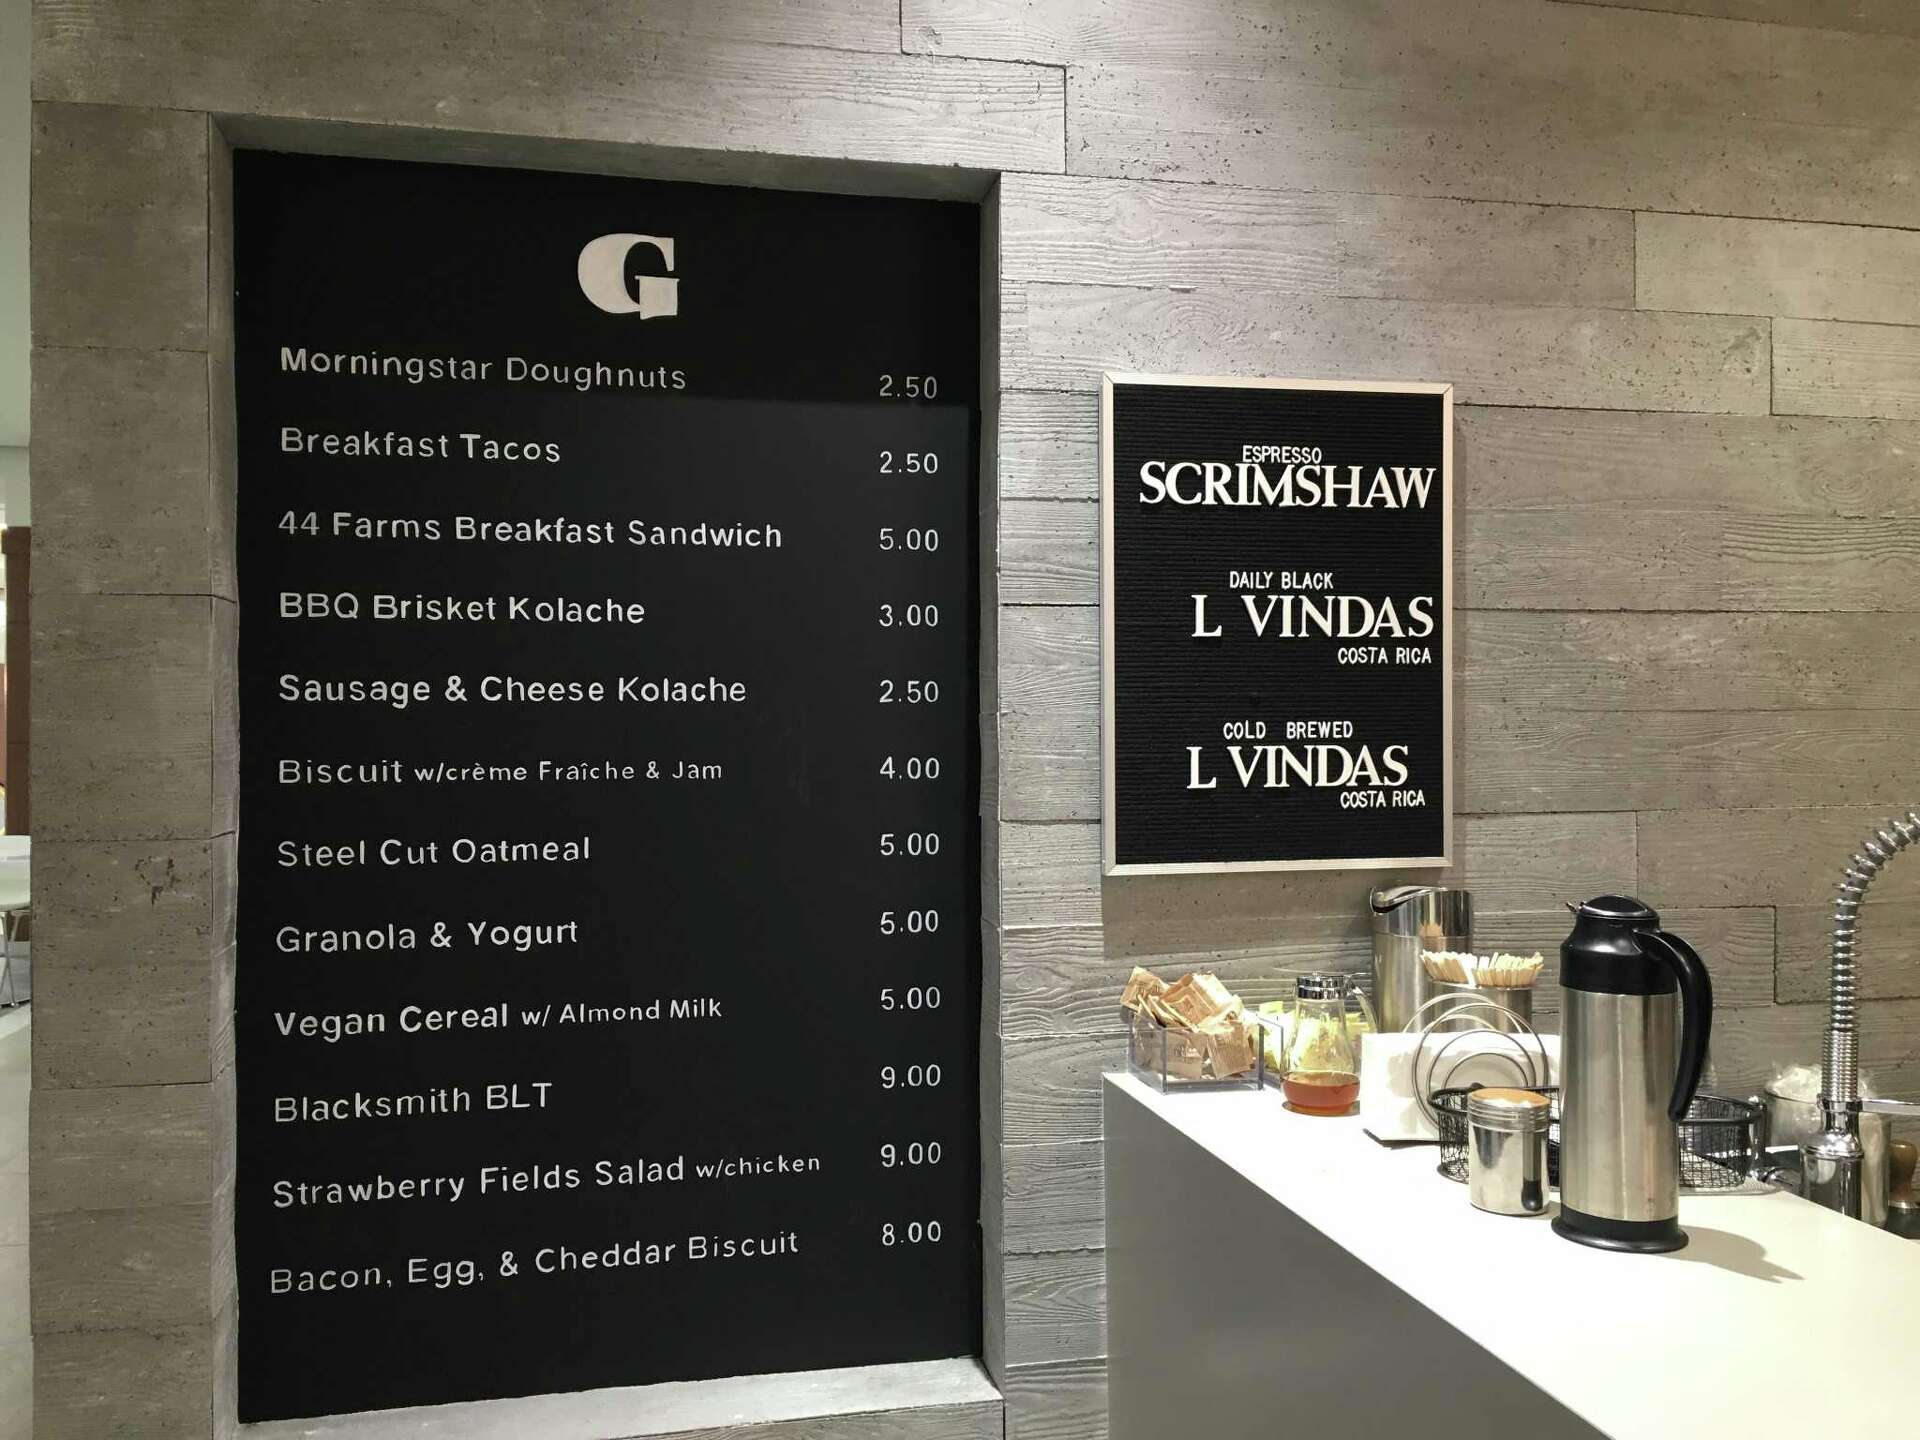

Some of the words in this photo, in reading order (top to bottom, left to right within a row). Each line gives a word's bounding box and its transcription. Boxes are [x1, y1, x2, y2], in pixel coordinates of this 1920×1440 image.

[577, 233, 680, 320] G
[281, 347, 493, 384] Morningstar
[506, 357, 686, 392] Doughnuts
[879, 374, 937, 399] 2.50
[281, 427, 449, 458] Breakfast
[459, 433, 561, 463] Tacos
[1242, 446, 1322, 465] ESPRESSO
[879, 450, 938, 474] 2.50
[1139, 460, 1436, 509] SCRIMSHAW
[278, 510, 320, 536] 44
[333, 512, 441, 541] Farms
[455, 516, 615, 544] Breakfast
[628, 519, 782, 548] Sandwich
[879, 527, 939, 552] 5.00
[1229, 570, 1274, 590] DAILY
[1281, 570, 1334, 591] BLACK
[280, 592, 359, 619] BBQ
[373, 594, 497, 621] Brisket
[508, 596, 645, 624] Kolache
[878, 604, 939, 627] 3.00
[1190, 594, 1223, 638] L
[1240, 594, 1434, 638] VINDAS
[1337, 646, 1389, 665] COSTA
[1395, 646, 1432, 665] RICA
[279, 674, 430, 710] Sausage
[444, 675, 468, 702] &
[480, 675, 605, 702] Cheese
[618, 676, 746, 702] Kolache
[879, 679, 939, 704] 2.50
[1222, 719, 1267, 740] COLD
[1286, 720, 1354, 740] BREWED
[279, 759, 403, 784] Biscuit
[414, 762, 528, 783] w/crème
[539, 760, 635, 781] Fraîche
[646, 760, 660, 779] &
[672, 760, 722, 780] Jam
[879, 756, 940, 780] 4.00
[1185, 746, 1217, 790] L
[1227, 744, 1409, 789] VINDAS
[1339, 789, 1387, 810] COSTA
[1392, 789, 1426, 808] RICA
[278, 840, 365, 867] Steel
[379, 839, 438, 866] Cut
[452, 836, 590, 864] Oatmeal
[880, 832, 940, 856] 5.00
[880, 909, 939, 935] 5.00
[276, 923, 416, 953] Granola
[430, 921, 452, 948] &
[467, 921, 578, 952] Yogurt
[880, 986, 941, 1011] 5.00
[274, 1012, 385, 1043] Vegan
[399, 1003, 508, 1033] Cereal
[521, 1004, 551, 1027] w/
[559, 999, 660, 1024] Almond
[669, 997, 722, 1019] Milk
[880, 1063, 941, 1089] 9.00
[275, 1087, 470, 1123] Blacksmith
[486, 1082, 553, 1110] BLT
[880, 1141, 941, 1168] 9.00
[273, 1174, 465, 1208] Strawberry
[480, 1164, 581, 1194] Fields
[594, 1155, 684, 1186] Salad
[695, 1154, 820, 1179] w/chicken
[881, 1220, 941, 1246] 8.00
[271, 1267, 392, 1294] Bacon,
[408, 1258, 484, 1289] Egg,
[499, 1250, 519, 1277] &
[535, 1240, 676, 1273] Cheddar
[688, 1231, 799, 1260] Biscuit
